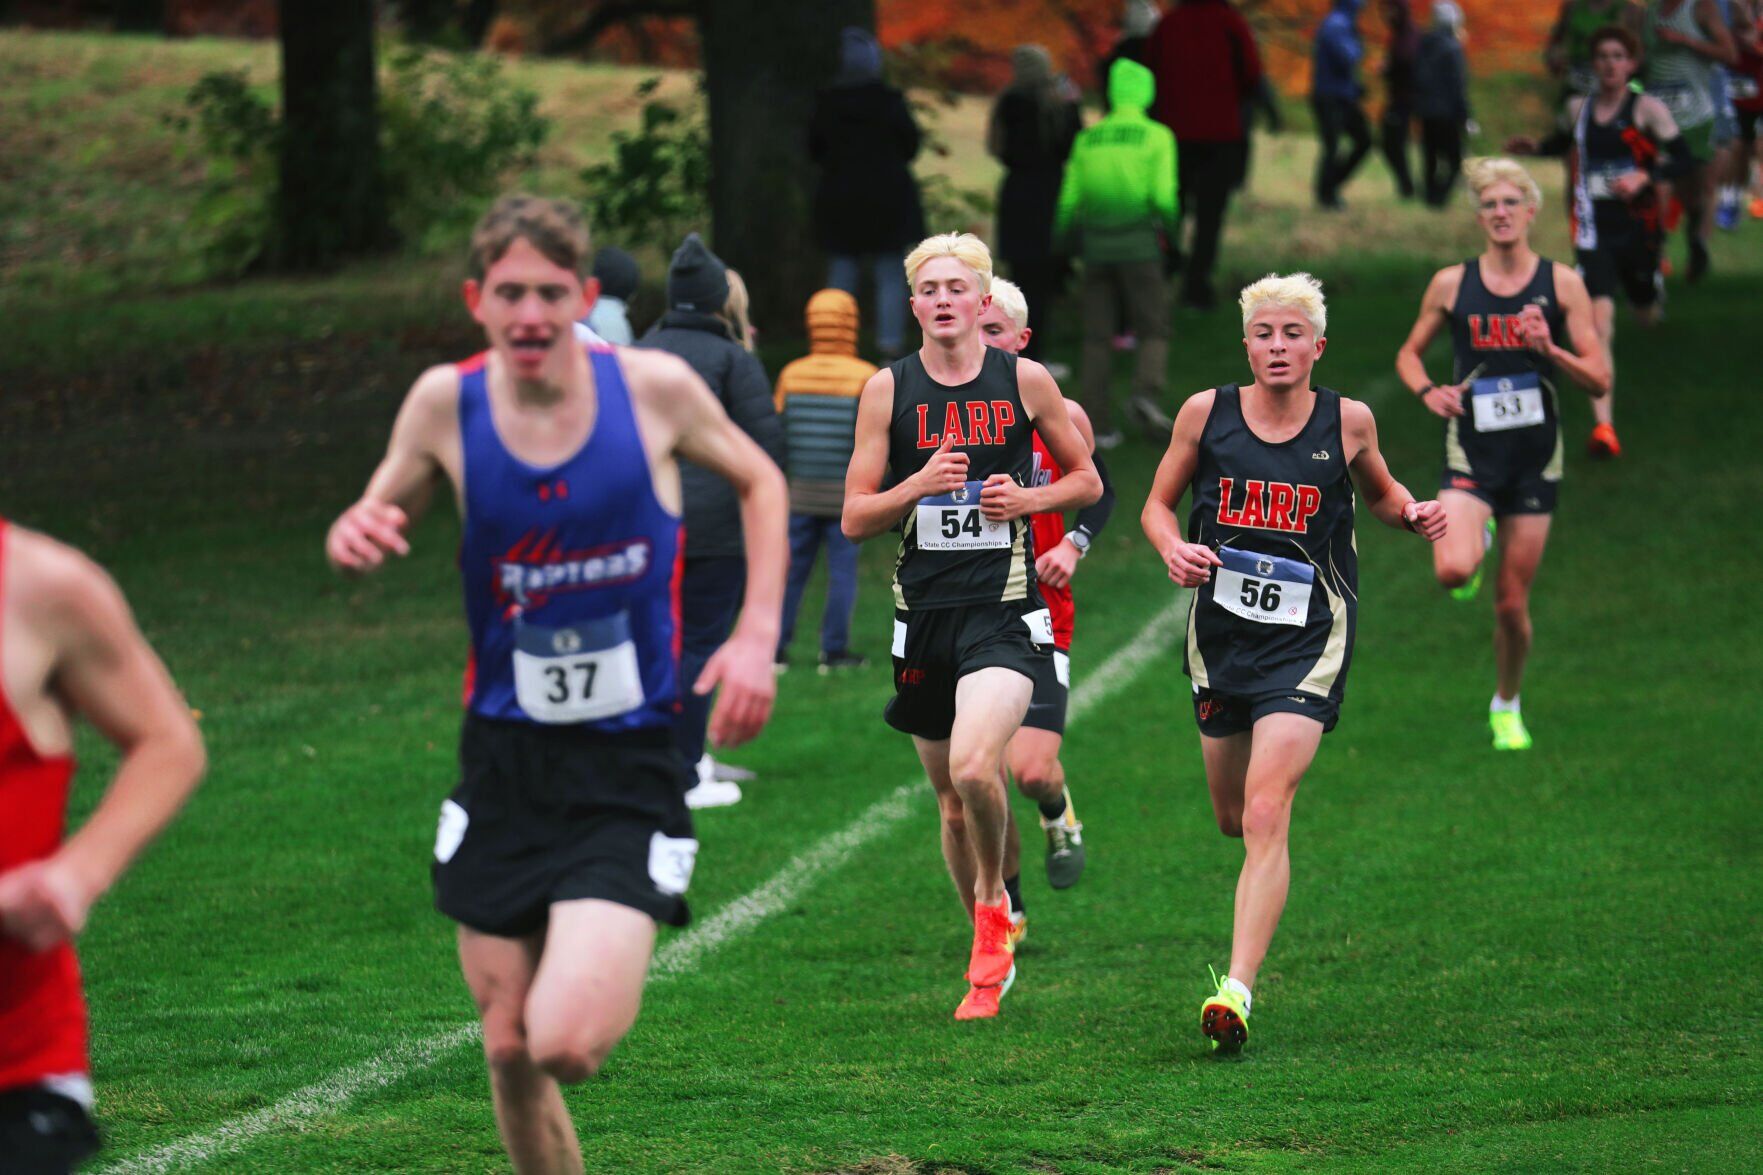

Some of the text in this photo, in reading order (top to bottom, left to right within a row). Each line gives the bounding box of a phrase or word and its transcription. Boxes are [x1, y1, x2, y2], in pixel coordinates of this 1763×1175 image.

[1493, 396, 1522, 416] 53
[917, 401, 1016, 449] LARP
[1217, 478, 1321, 534] LARP
[942, 509, 982, 538] 54
[951, 540, 1003, 549] Championships
[1240, 578, 1282, 612] 56
[543, 661, 598, 704] 37
